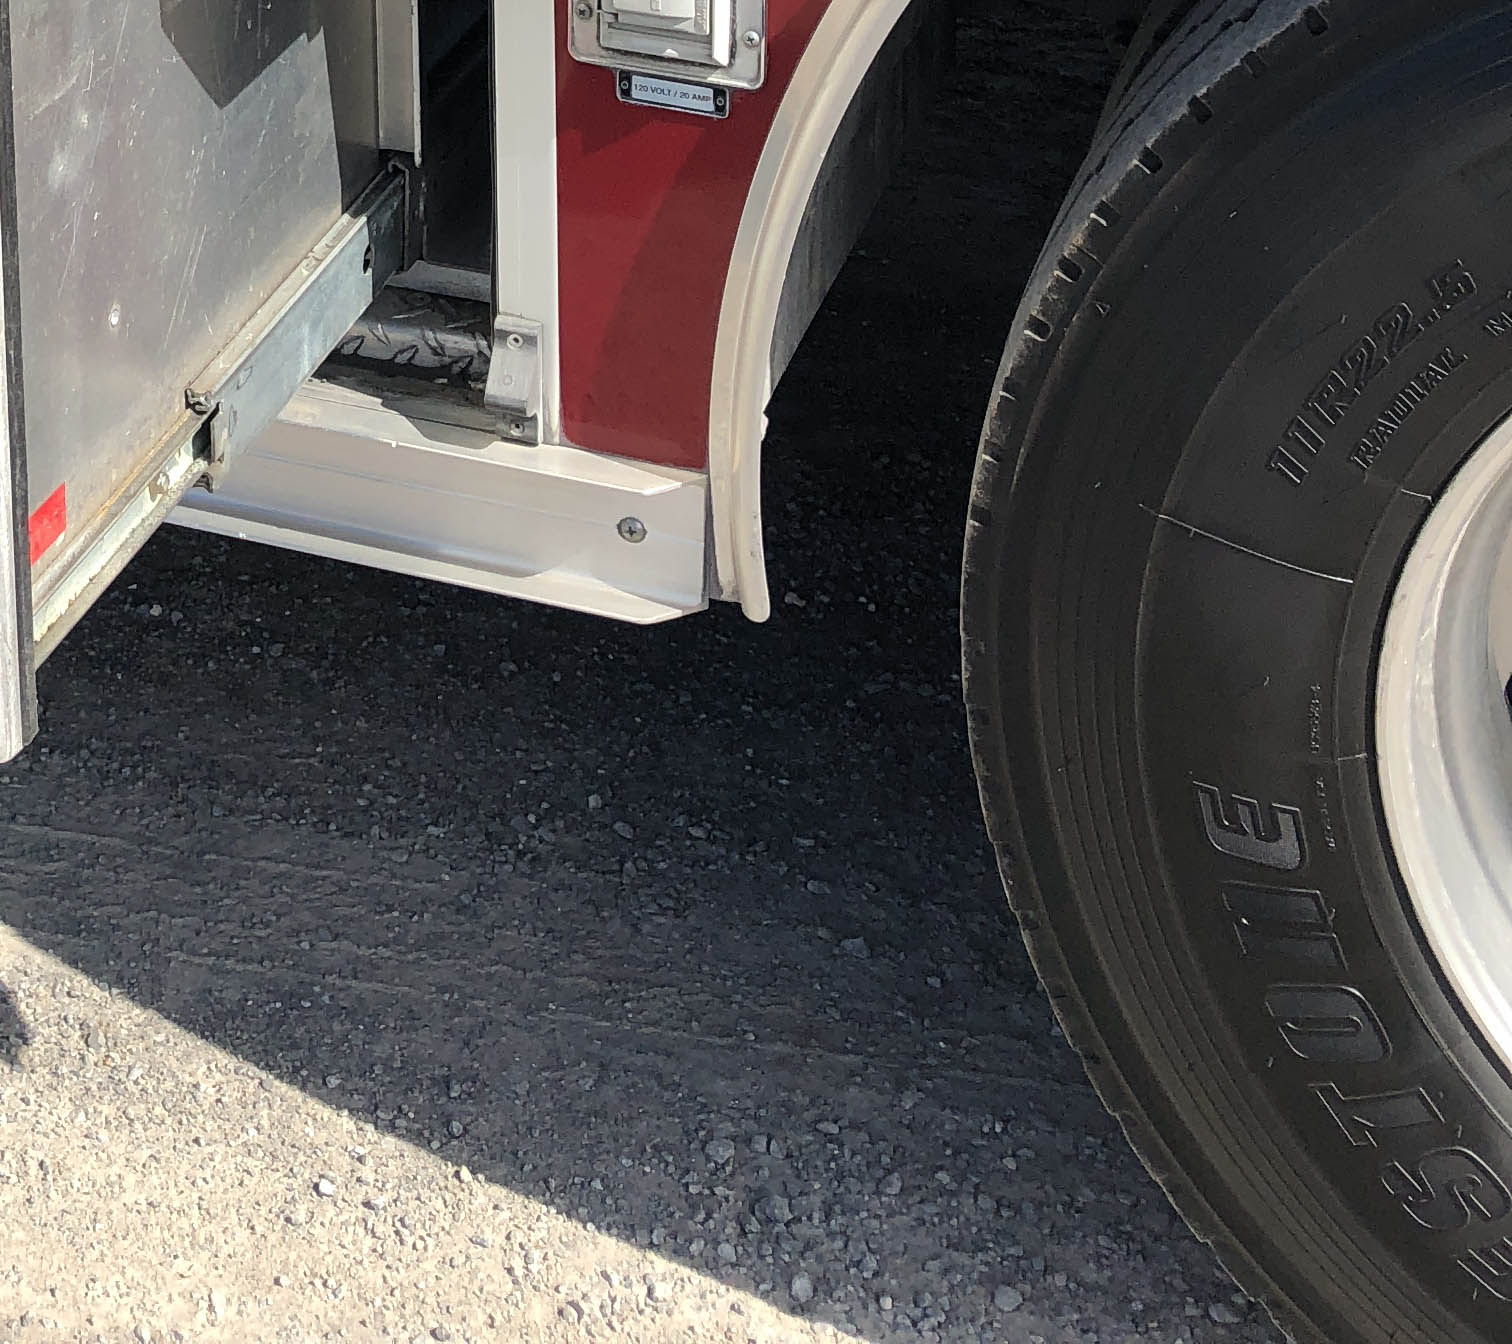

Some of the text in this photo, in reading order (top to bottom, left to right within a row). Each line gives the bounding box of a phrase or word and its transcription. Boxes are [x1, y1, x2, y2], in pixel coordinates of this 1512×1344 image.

[634, 83, 648, 93] 120
[650, 86, 671, 97] VOLT
[679, 91, 690, 100] 20
[1349, 346, 1469, 471] RADIAL
